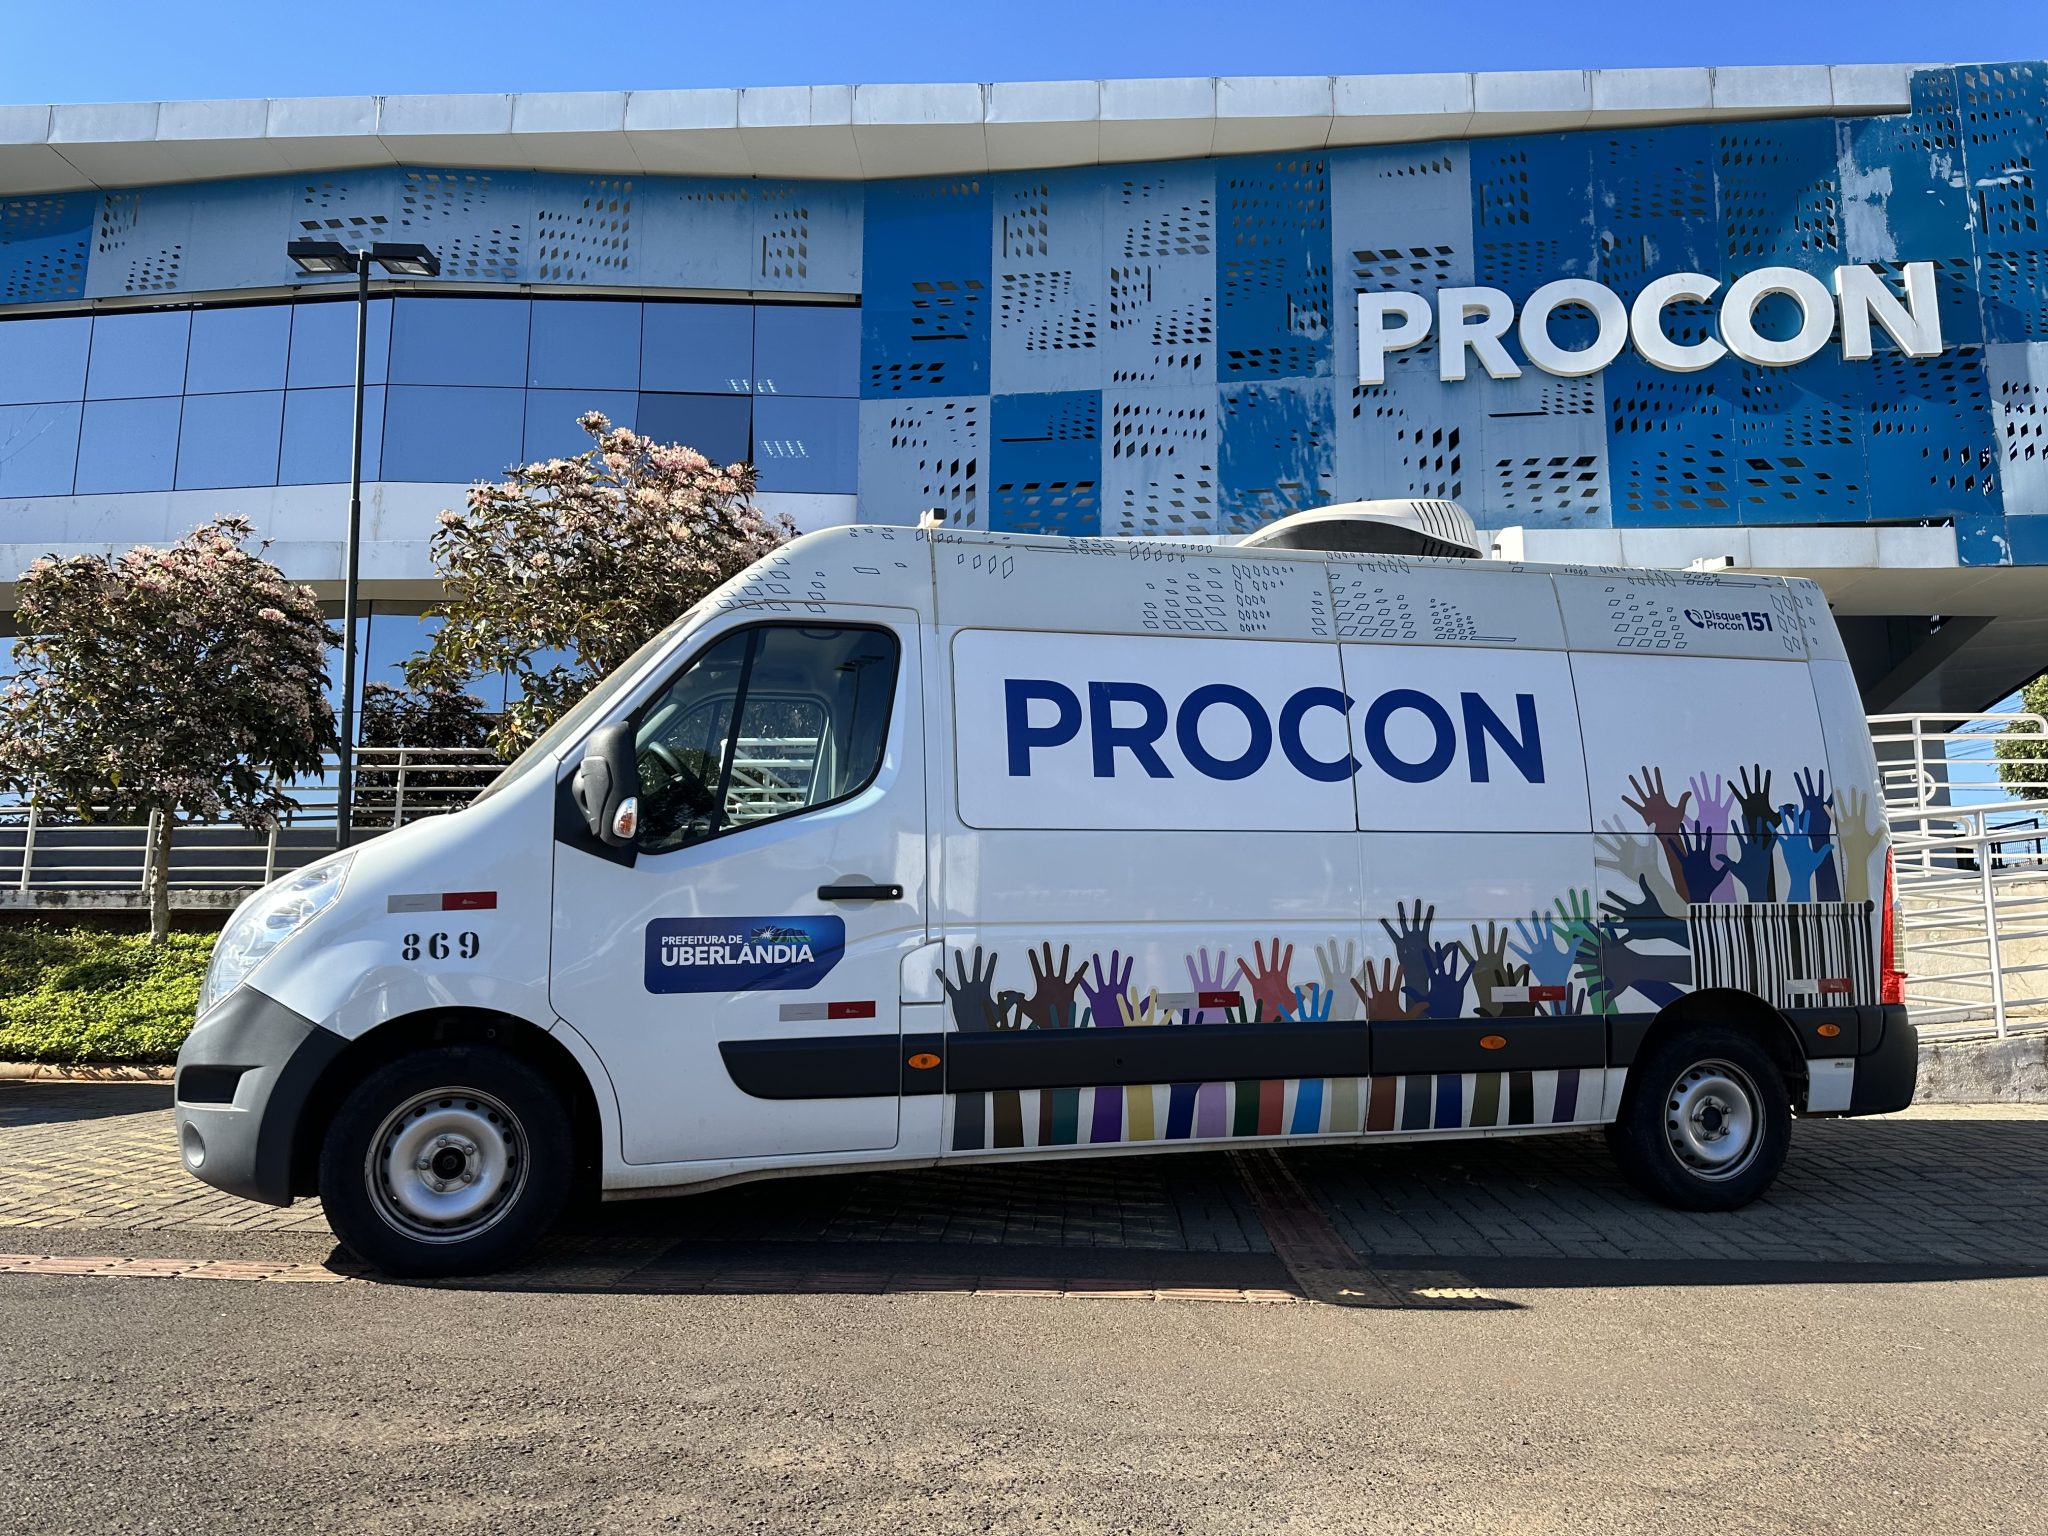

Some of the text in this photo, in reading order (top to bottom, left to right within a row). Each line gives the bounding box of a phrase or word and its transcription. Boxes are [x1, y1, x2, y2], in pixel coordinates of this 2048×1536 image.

[1357, 262, 1944, 386] PROCON
[1703, 610, 1742, 622] Disque
[1705, 620, 1745, 631] Procon
[1741, 611, 1773, 632] 151
[1003, 678, 1546, 784] PROCON
[402, 931, 480, 961] 869
[661, 934, 743, 945] PREFEITURA DE
[661, 942, 815, 967] UBERLÂNDIA
